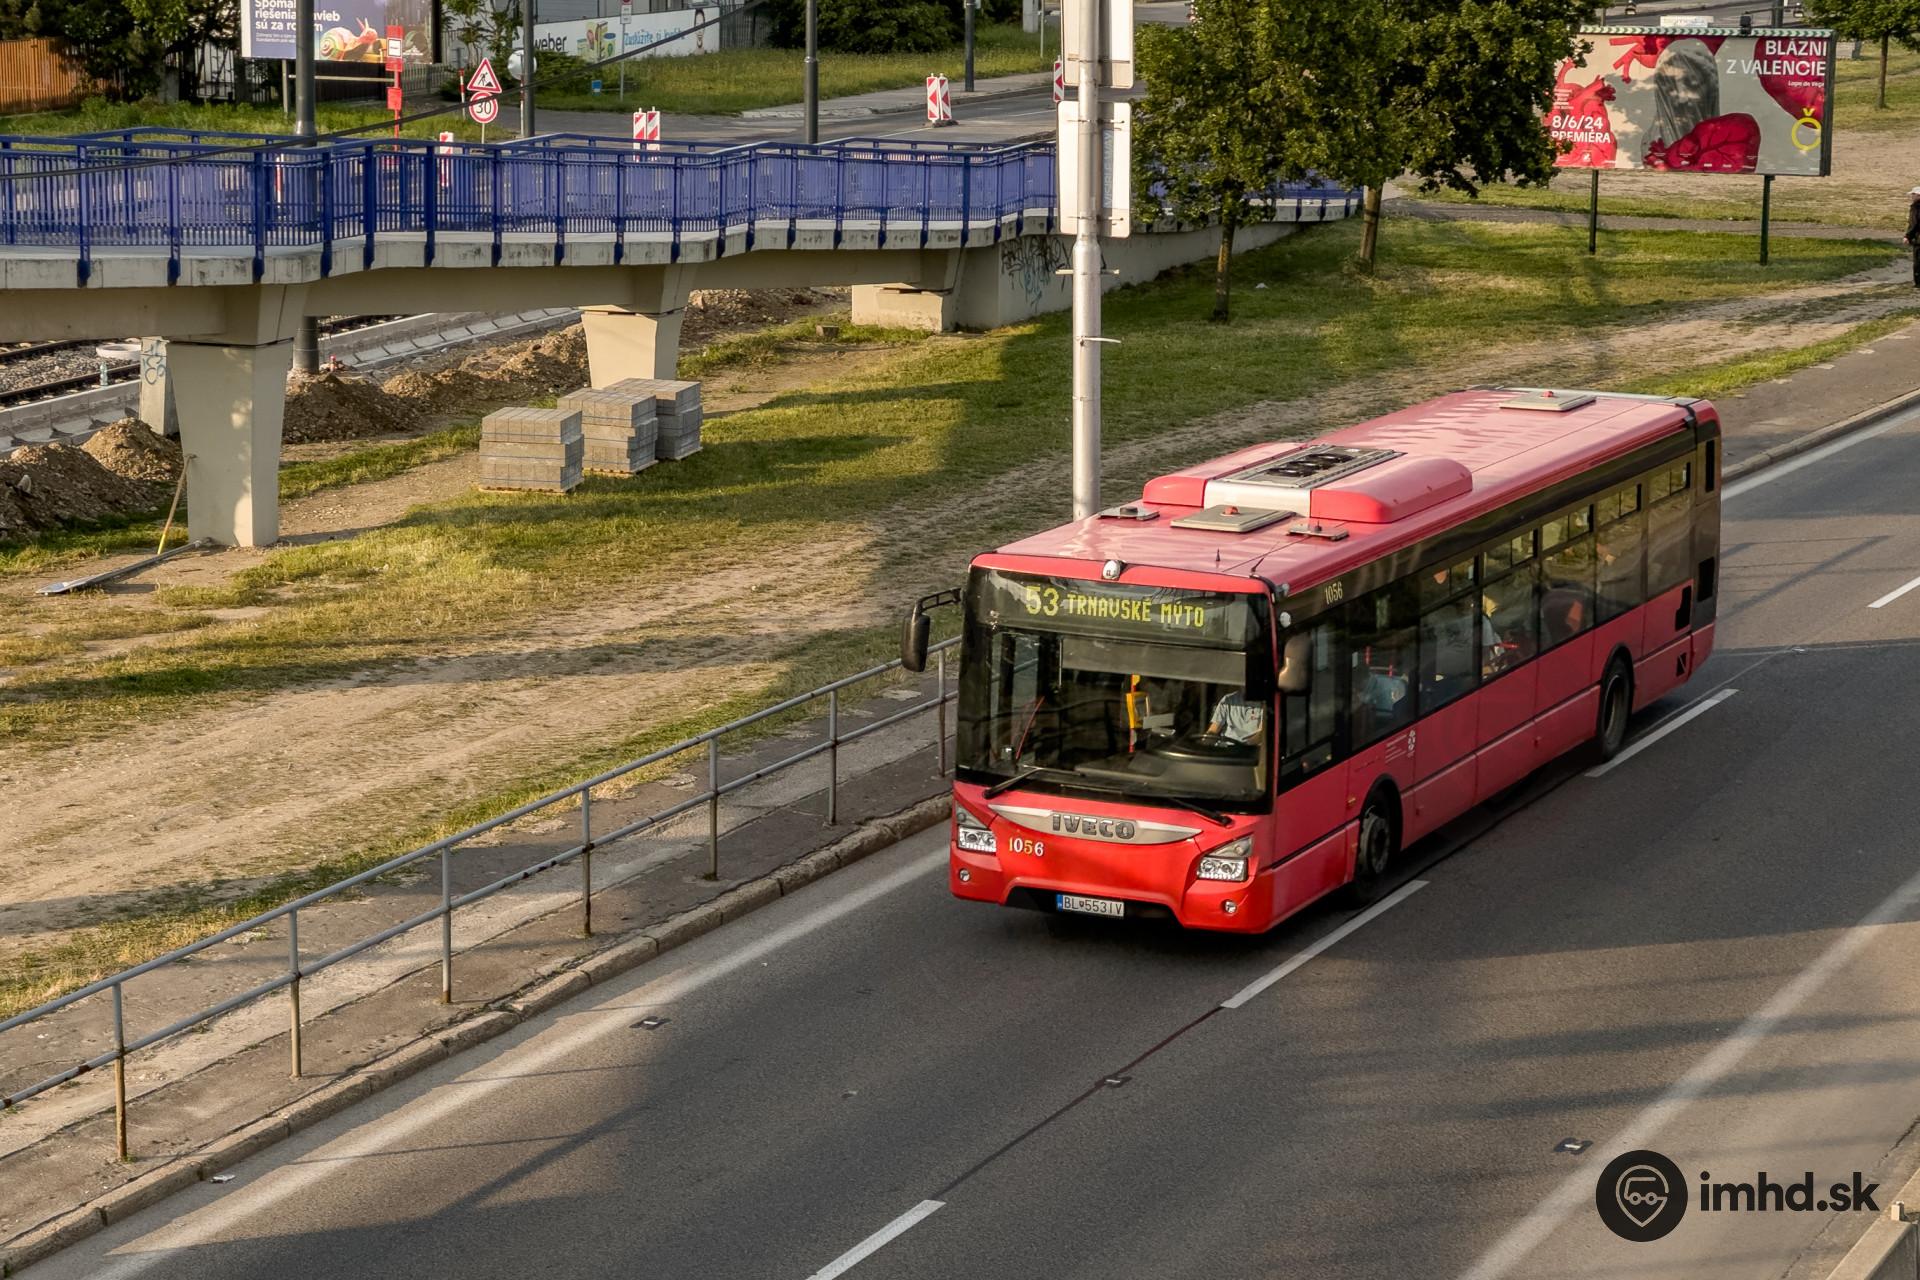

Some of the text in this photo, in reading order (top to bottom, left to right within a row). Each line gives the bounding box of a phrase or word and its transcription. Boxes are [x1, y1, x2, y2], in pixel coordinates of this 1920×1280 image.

[255, 19, 268, 29] sú
[270, 20, 284, 31] za
[533, 33, 567, 52] weber
[1765, 39, 1827, 57] BLÁZNI
[1726, 59, 1826, 76] Z VALENCIE
[476, 101, 492, 115] 30
[1552, 115, 1604, 130] 8/6/24
[1325, 581, 1343, 605] 1056
[1025, 585, 1205, 628] 53 TRNAVSKÉ MÝTO
[1052, 814, 1135, 840] IVECO
[1009, 837, 1044, 857] 1056
